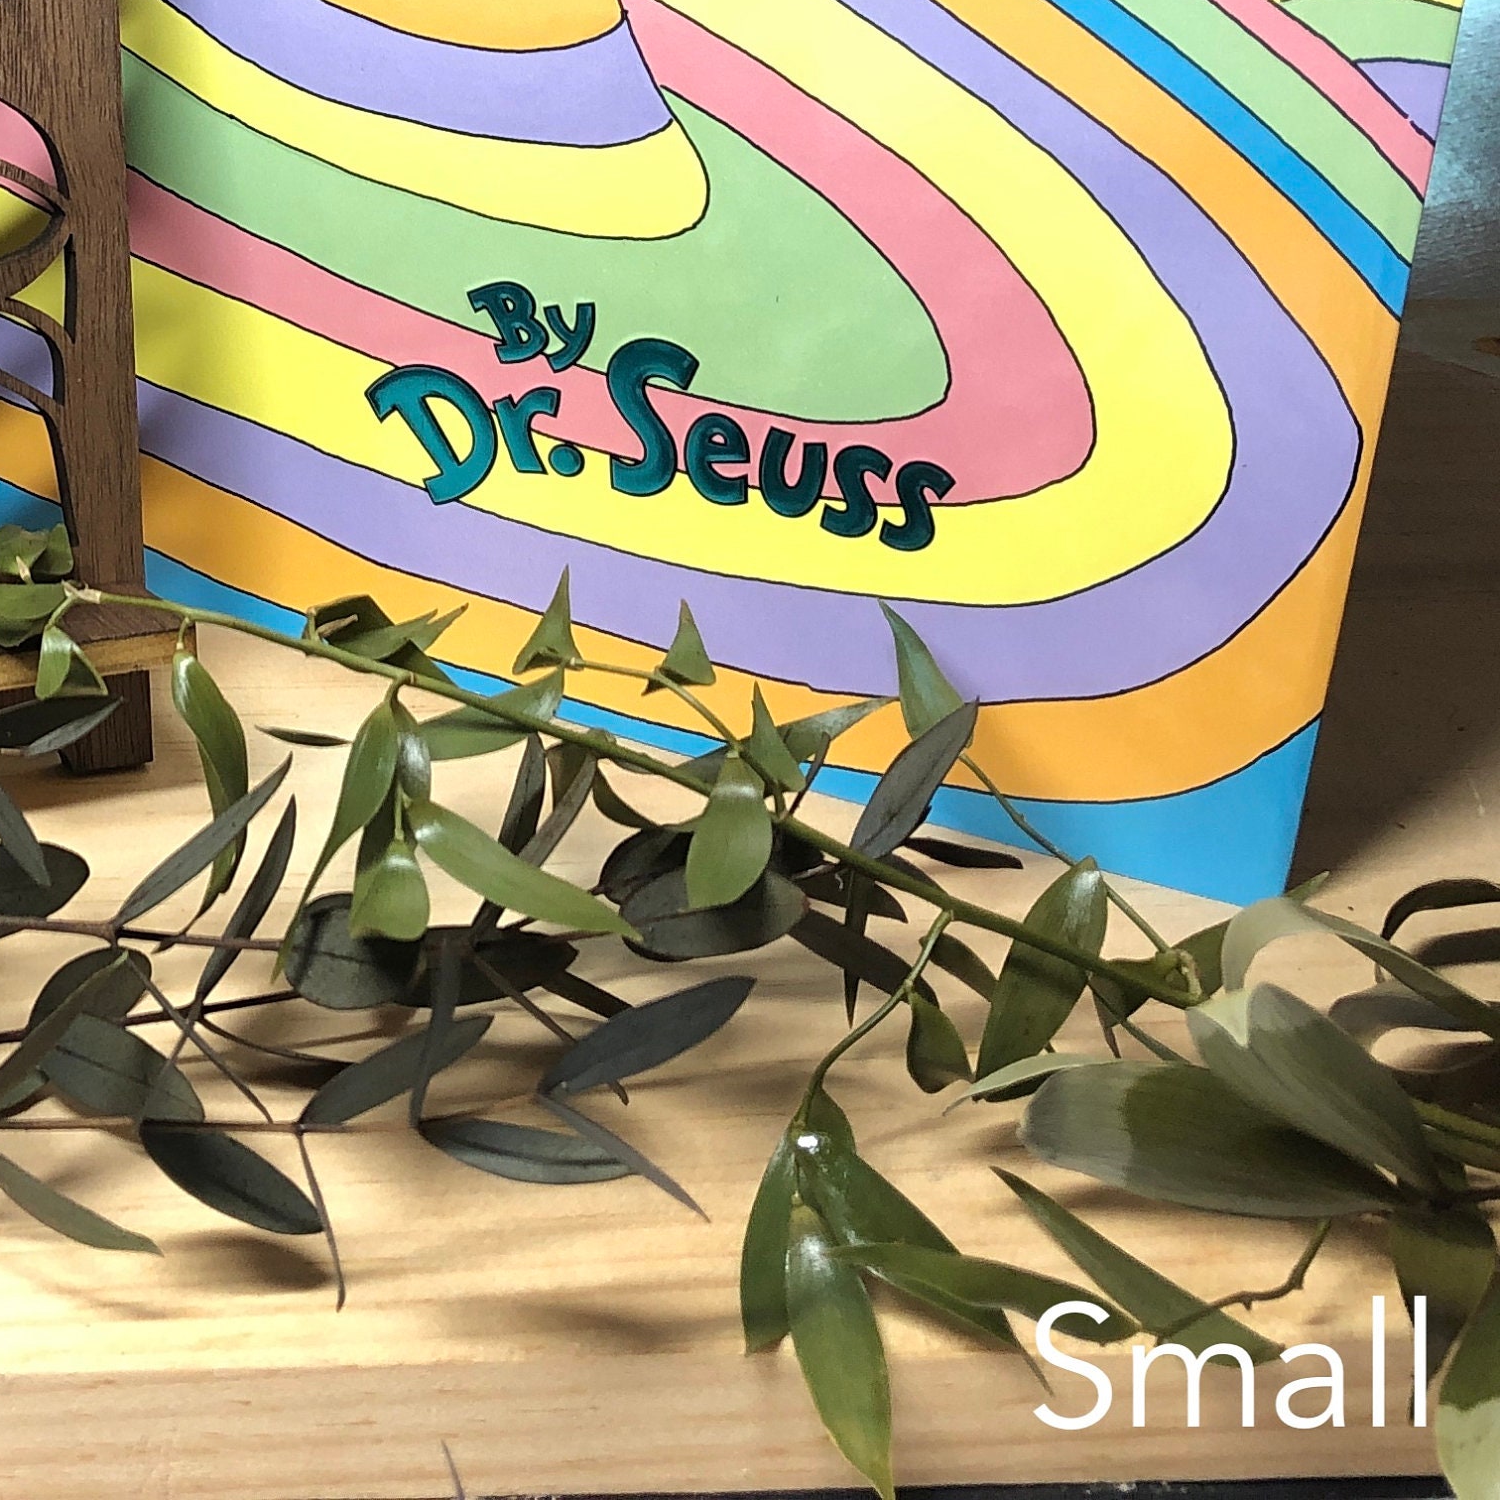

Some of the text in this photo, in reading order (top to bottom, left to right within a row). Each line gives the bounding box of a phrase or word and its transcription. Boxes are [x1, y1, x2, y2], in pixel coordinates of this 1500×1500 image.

[466, 280, 596, 372] By
[364, 337, 956, 551] Dr. Seuss
